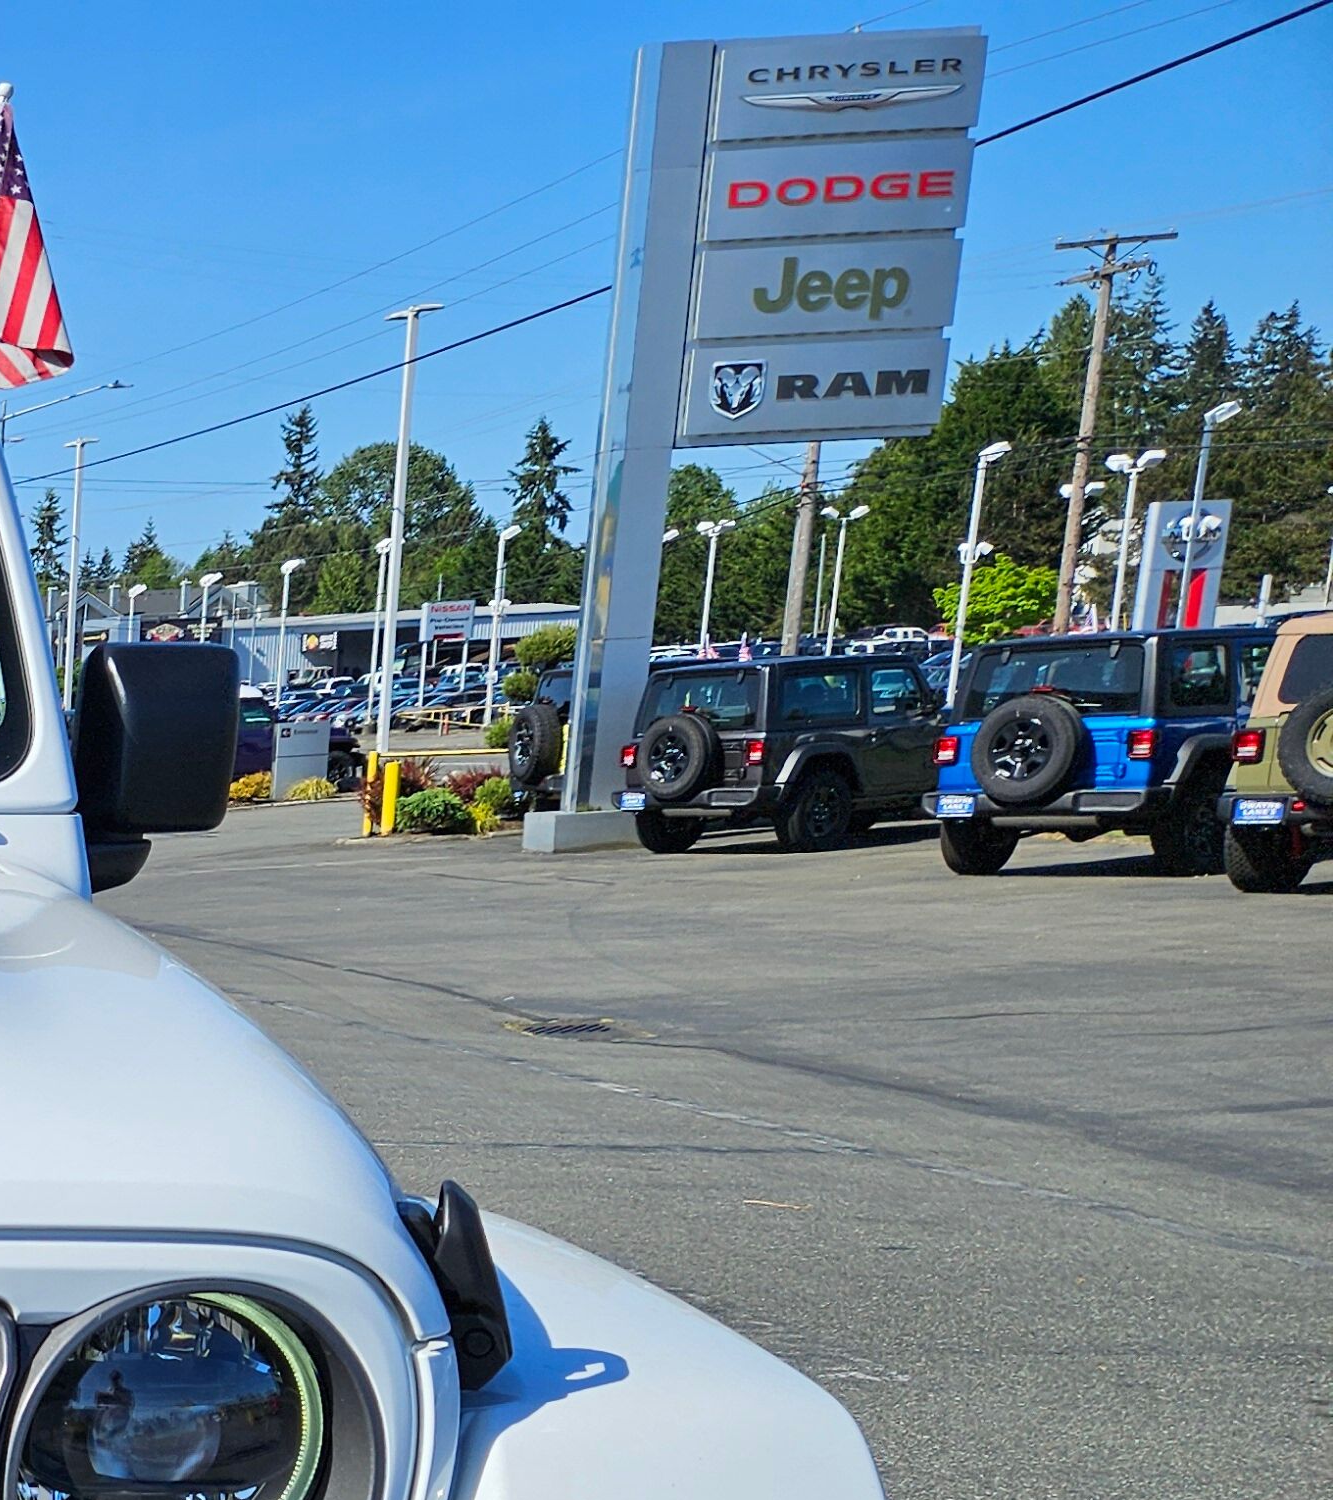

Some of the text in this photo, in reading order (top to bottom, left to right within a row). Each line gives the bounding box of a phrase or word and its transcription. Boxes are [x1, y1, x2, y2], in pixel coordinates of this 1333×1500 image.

[746, 57, 964, 84] CHRYSLER
[727, 170, 955, 209] DODGE
[752, 257, 910, 321] Jeep
[776, 369, 931, 402] RAM
[430, 604, 471, 613] NISSAN
